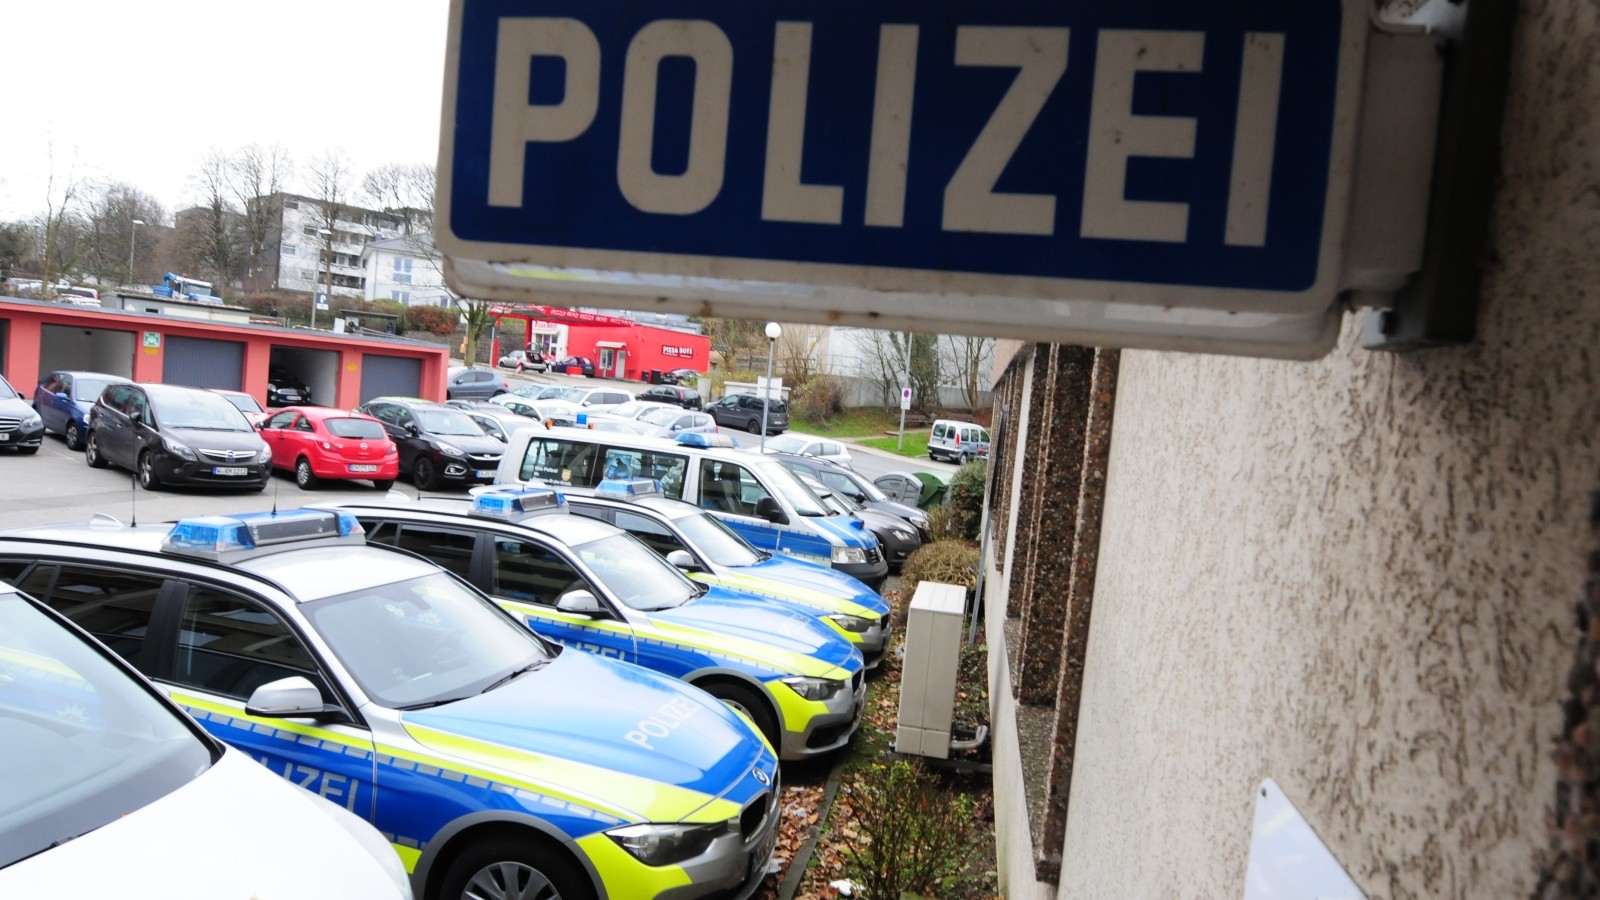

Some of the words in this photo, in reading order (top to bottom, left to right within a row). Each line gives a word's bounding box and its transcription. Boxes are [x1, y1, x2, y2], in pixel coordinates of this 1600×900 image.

[488, 15, 1287, 248] POLIZEI
[662, 346, 679, 355] PIZZA
[679, 347, 693, 355] BOYS
